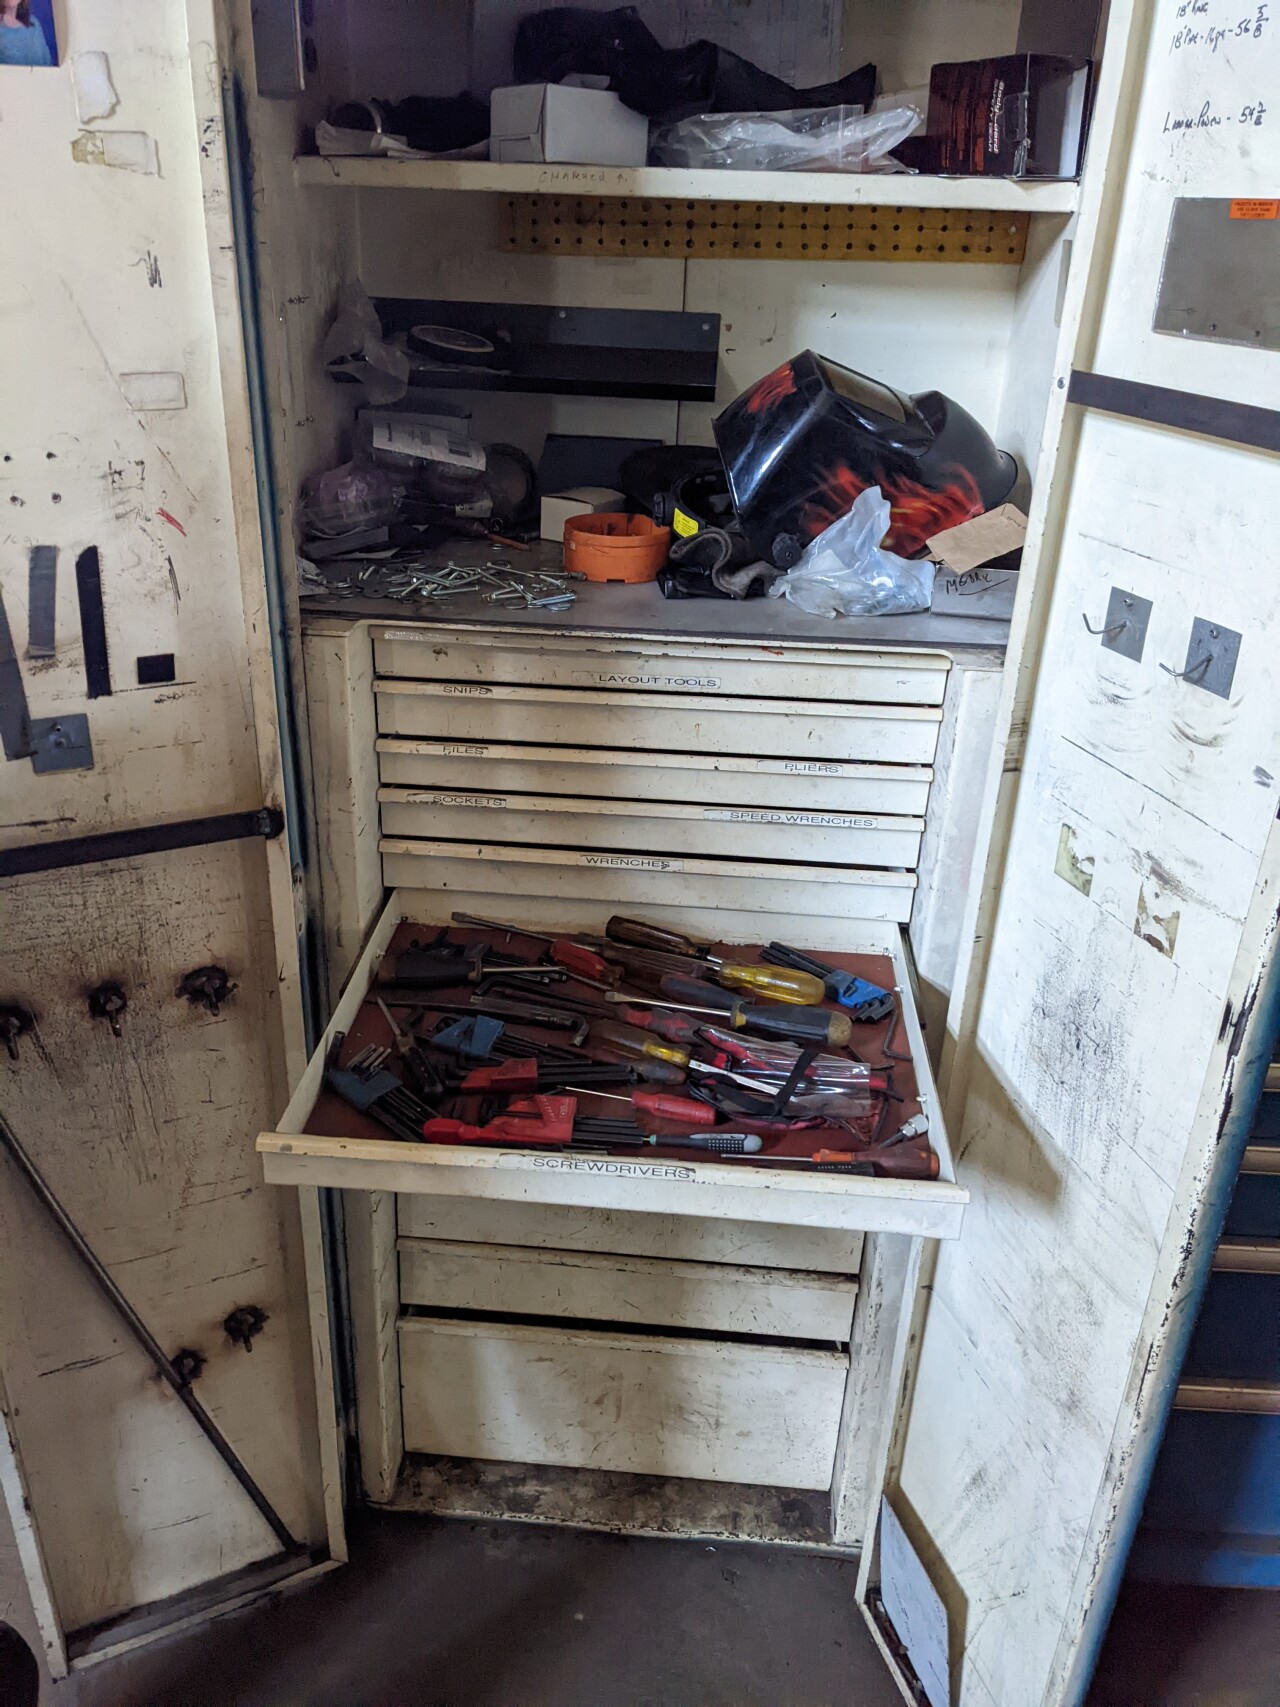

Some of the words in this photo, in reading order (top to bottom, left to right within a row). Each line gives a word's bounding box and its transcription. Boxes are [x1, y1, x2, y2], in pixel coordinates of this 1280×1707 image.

[599, 674, 661, 685] LAYOUT
[665, 677, 717, 687] TOOLS
[442, 685, 489, 695] SNIPS
[442, 745, 485, 755] FILES
[784, 762, 840, 774] PLIERS
[432, 795, 503, 807] SOCKETS
[729, 811, 782, 822] SPEED
[785, 814, 874, 827] WRENCHES
[532, 1157, 691, 1179] SCREWDRIVERS
